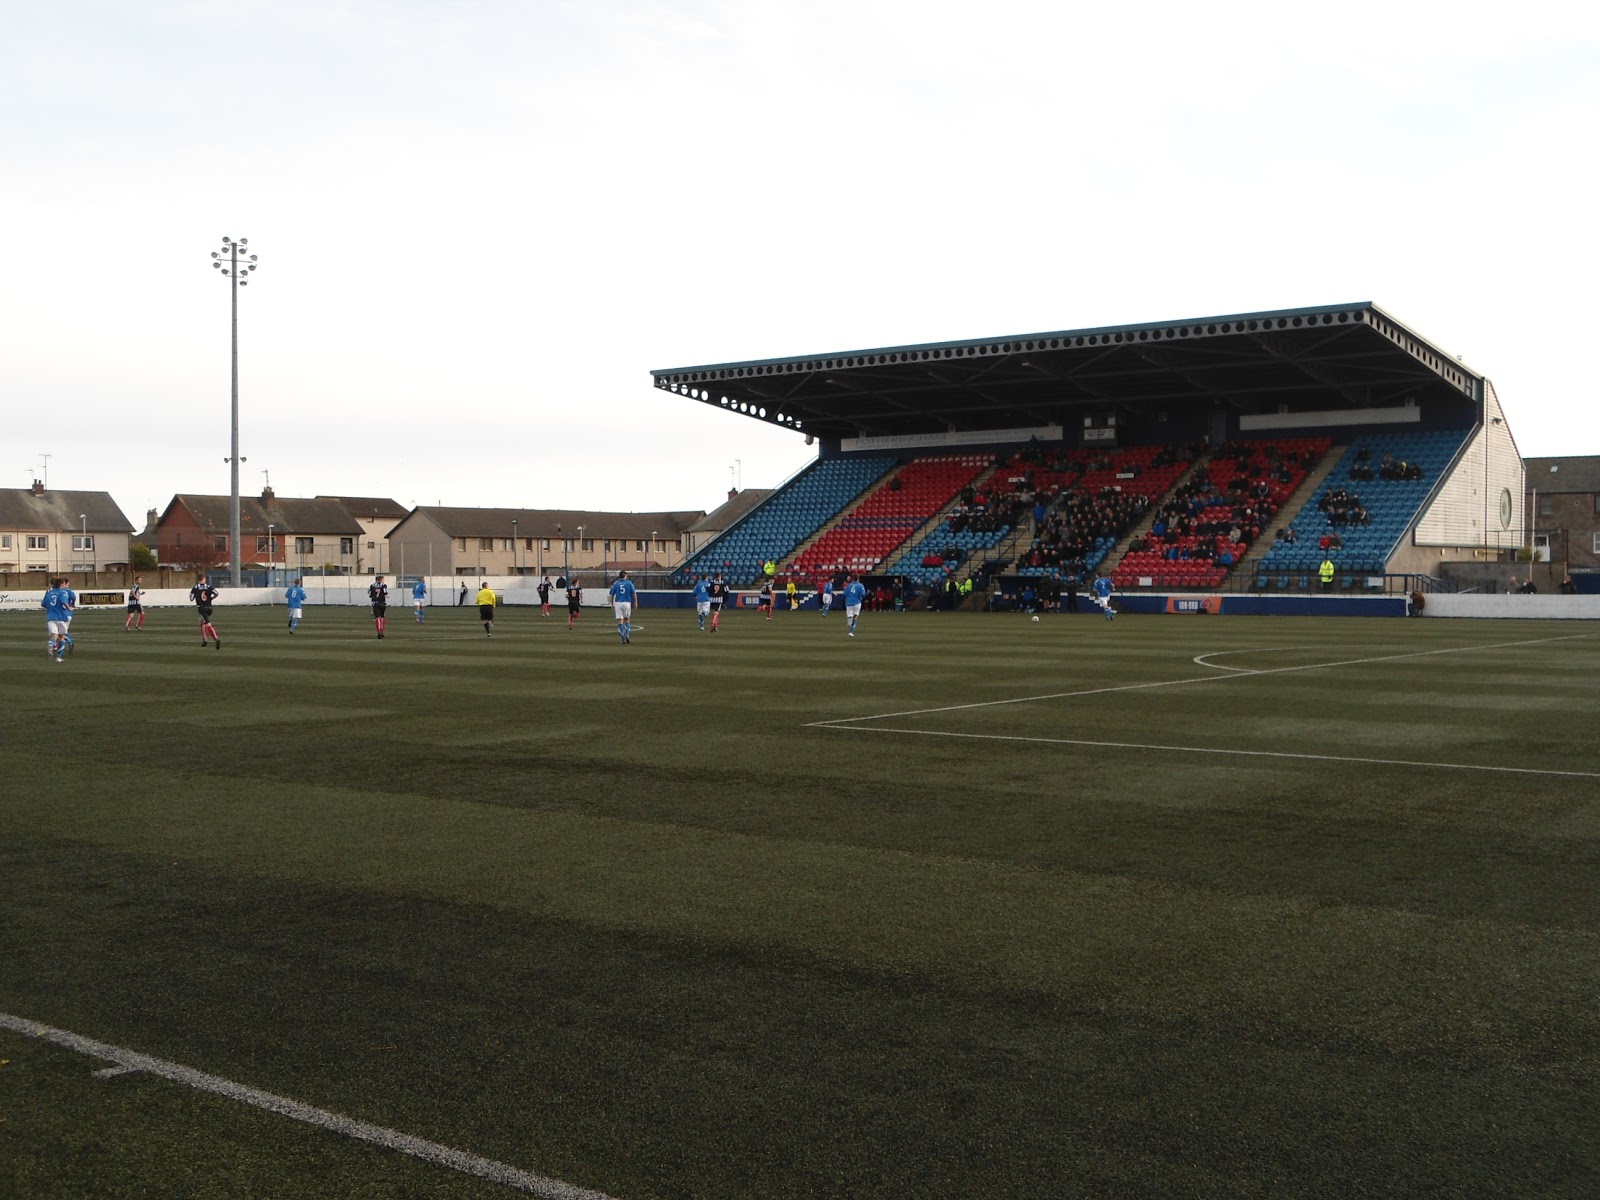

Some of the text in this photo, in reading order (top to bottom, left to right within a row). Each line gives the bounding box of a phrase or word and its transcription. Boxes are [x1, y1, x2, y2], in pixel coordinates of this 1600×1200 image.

[855, 434, 946, 445] FOTHERINGHAM
[375, 589, 380, 598] 7
[619, 585, 625, 594] 5
[714, 586, 720, 594] 9
[850, 586, 856, 594] 4
[51, 595, 57, 606] 3
[82, 594, 91, 602] THE
[91, 594, 110, 602] MARKET
[201, 591, 207, 601] 6
